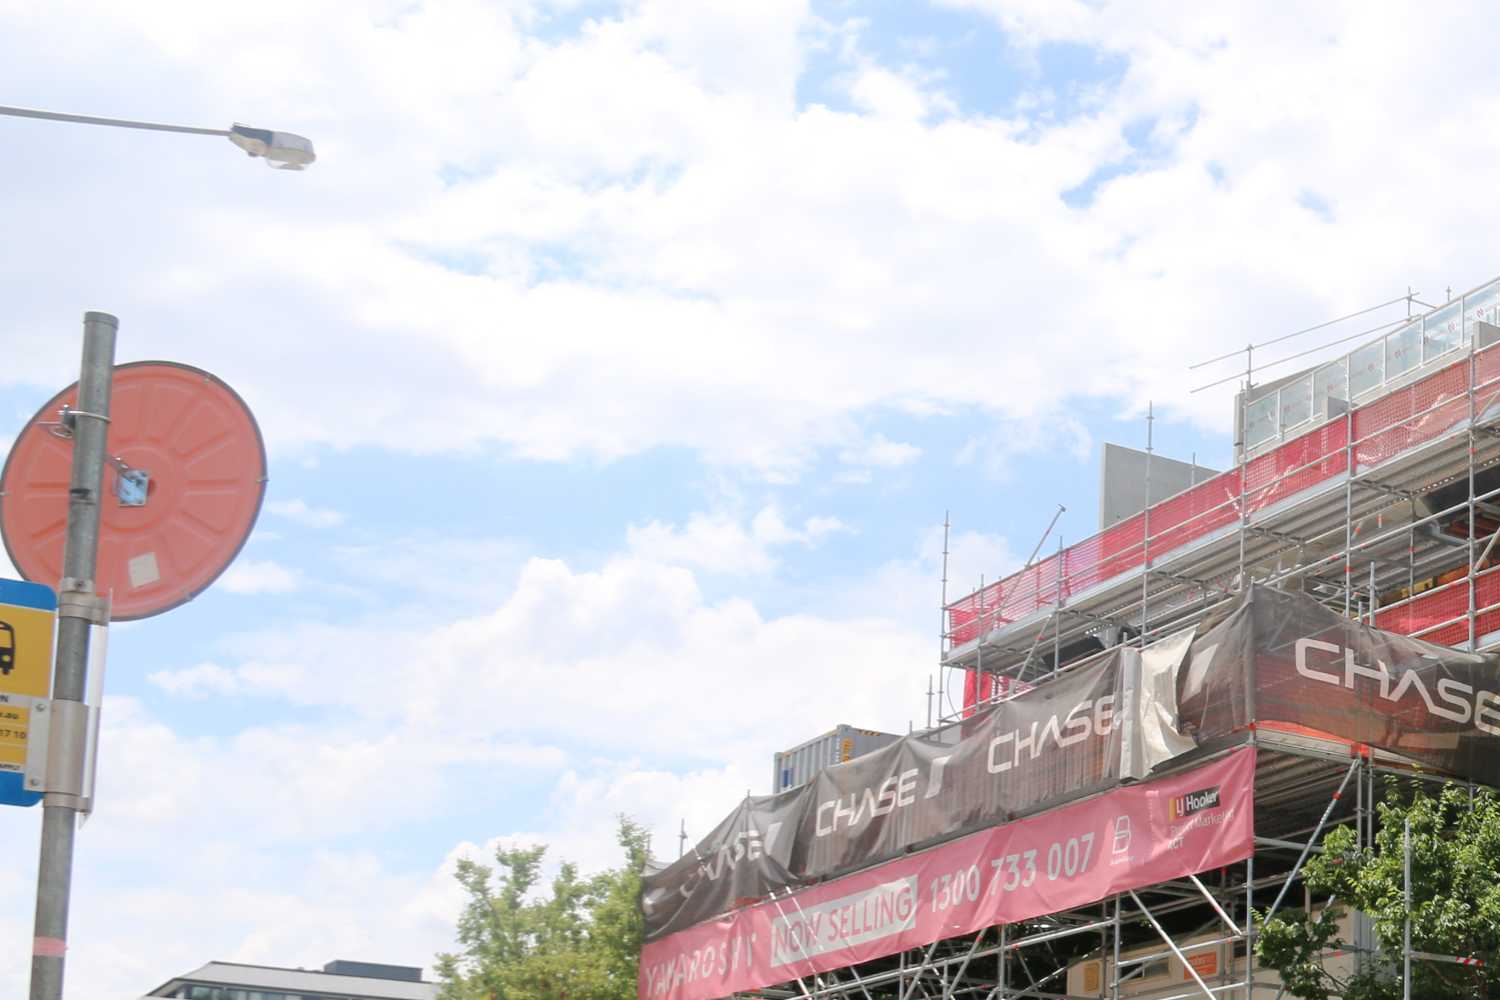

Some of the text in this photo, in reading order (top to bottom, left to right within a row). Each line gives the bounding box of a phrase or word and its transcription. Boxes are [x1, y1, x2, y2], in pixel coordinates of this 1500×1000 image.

[988, 694, 1117, 774] CHASE
[815, 768, 919, 838] CHASE
[1186, 790, 1218, 811] Hooker
[773, 911, 821, 956] NOW
[827, 884, 914, 941] SELLING
[931, 864, 981, 913] 1300
[990, 849, 1038, 896] 733
[1047, 831, 1096, 881] 007
